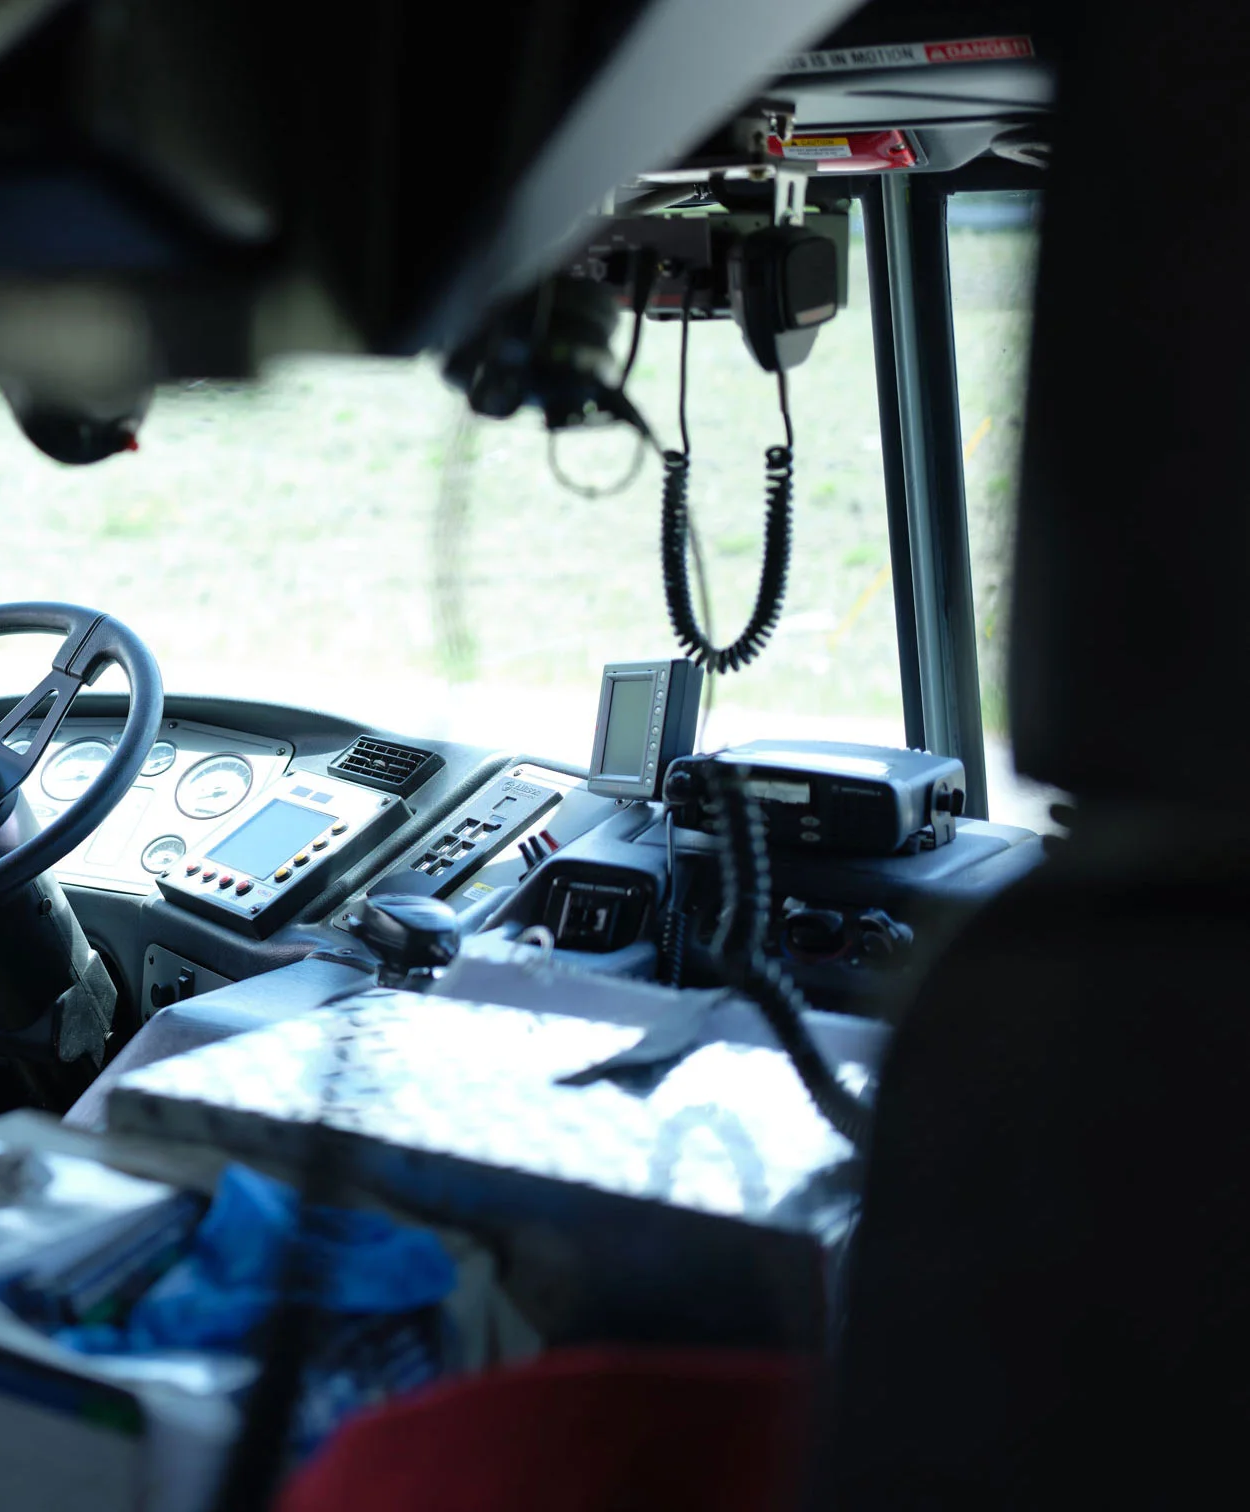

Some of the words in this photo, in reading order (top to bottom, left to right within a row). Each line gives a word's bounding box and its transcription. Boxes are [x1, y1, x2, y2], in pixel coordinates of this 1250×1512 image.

[829, 52, 847, 65] IN
[851, 46, 914, 64] MOTION
[945, 39, 1028, 57] DANGER
